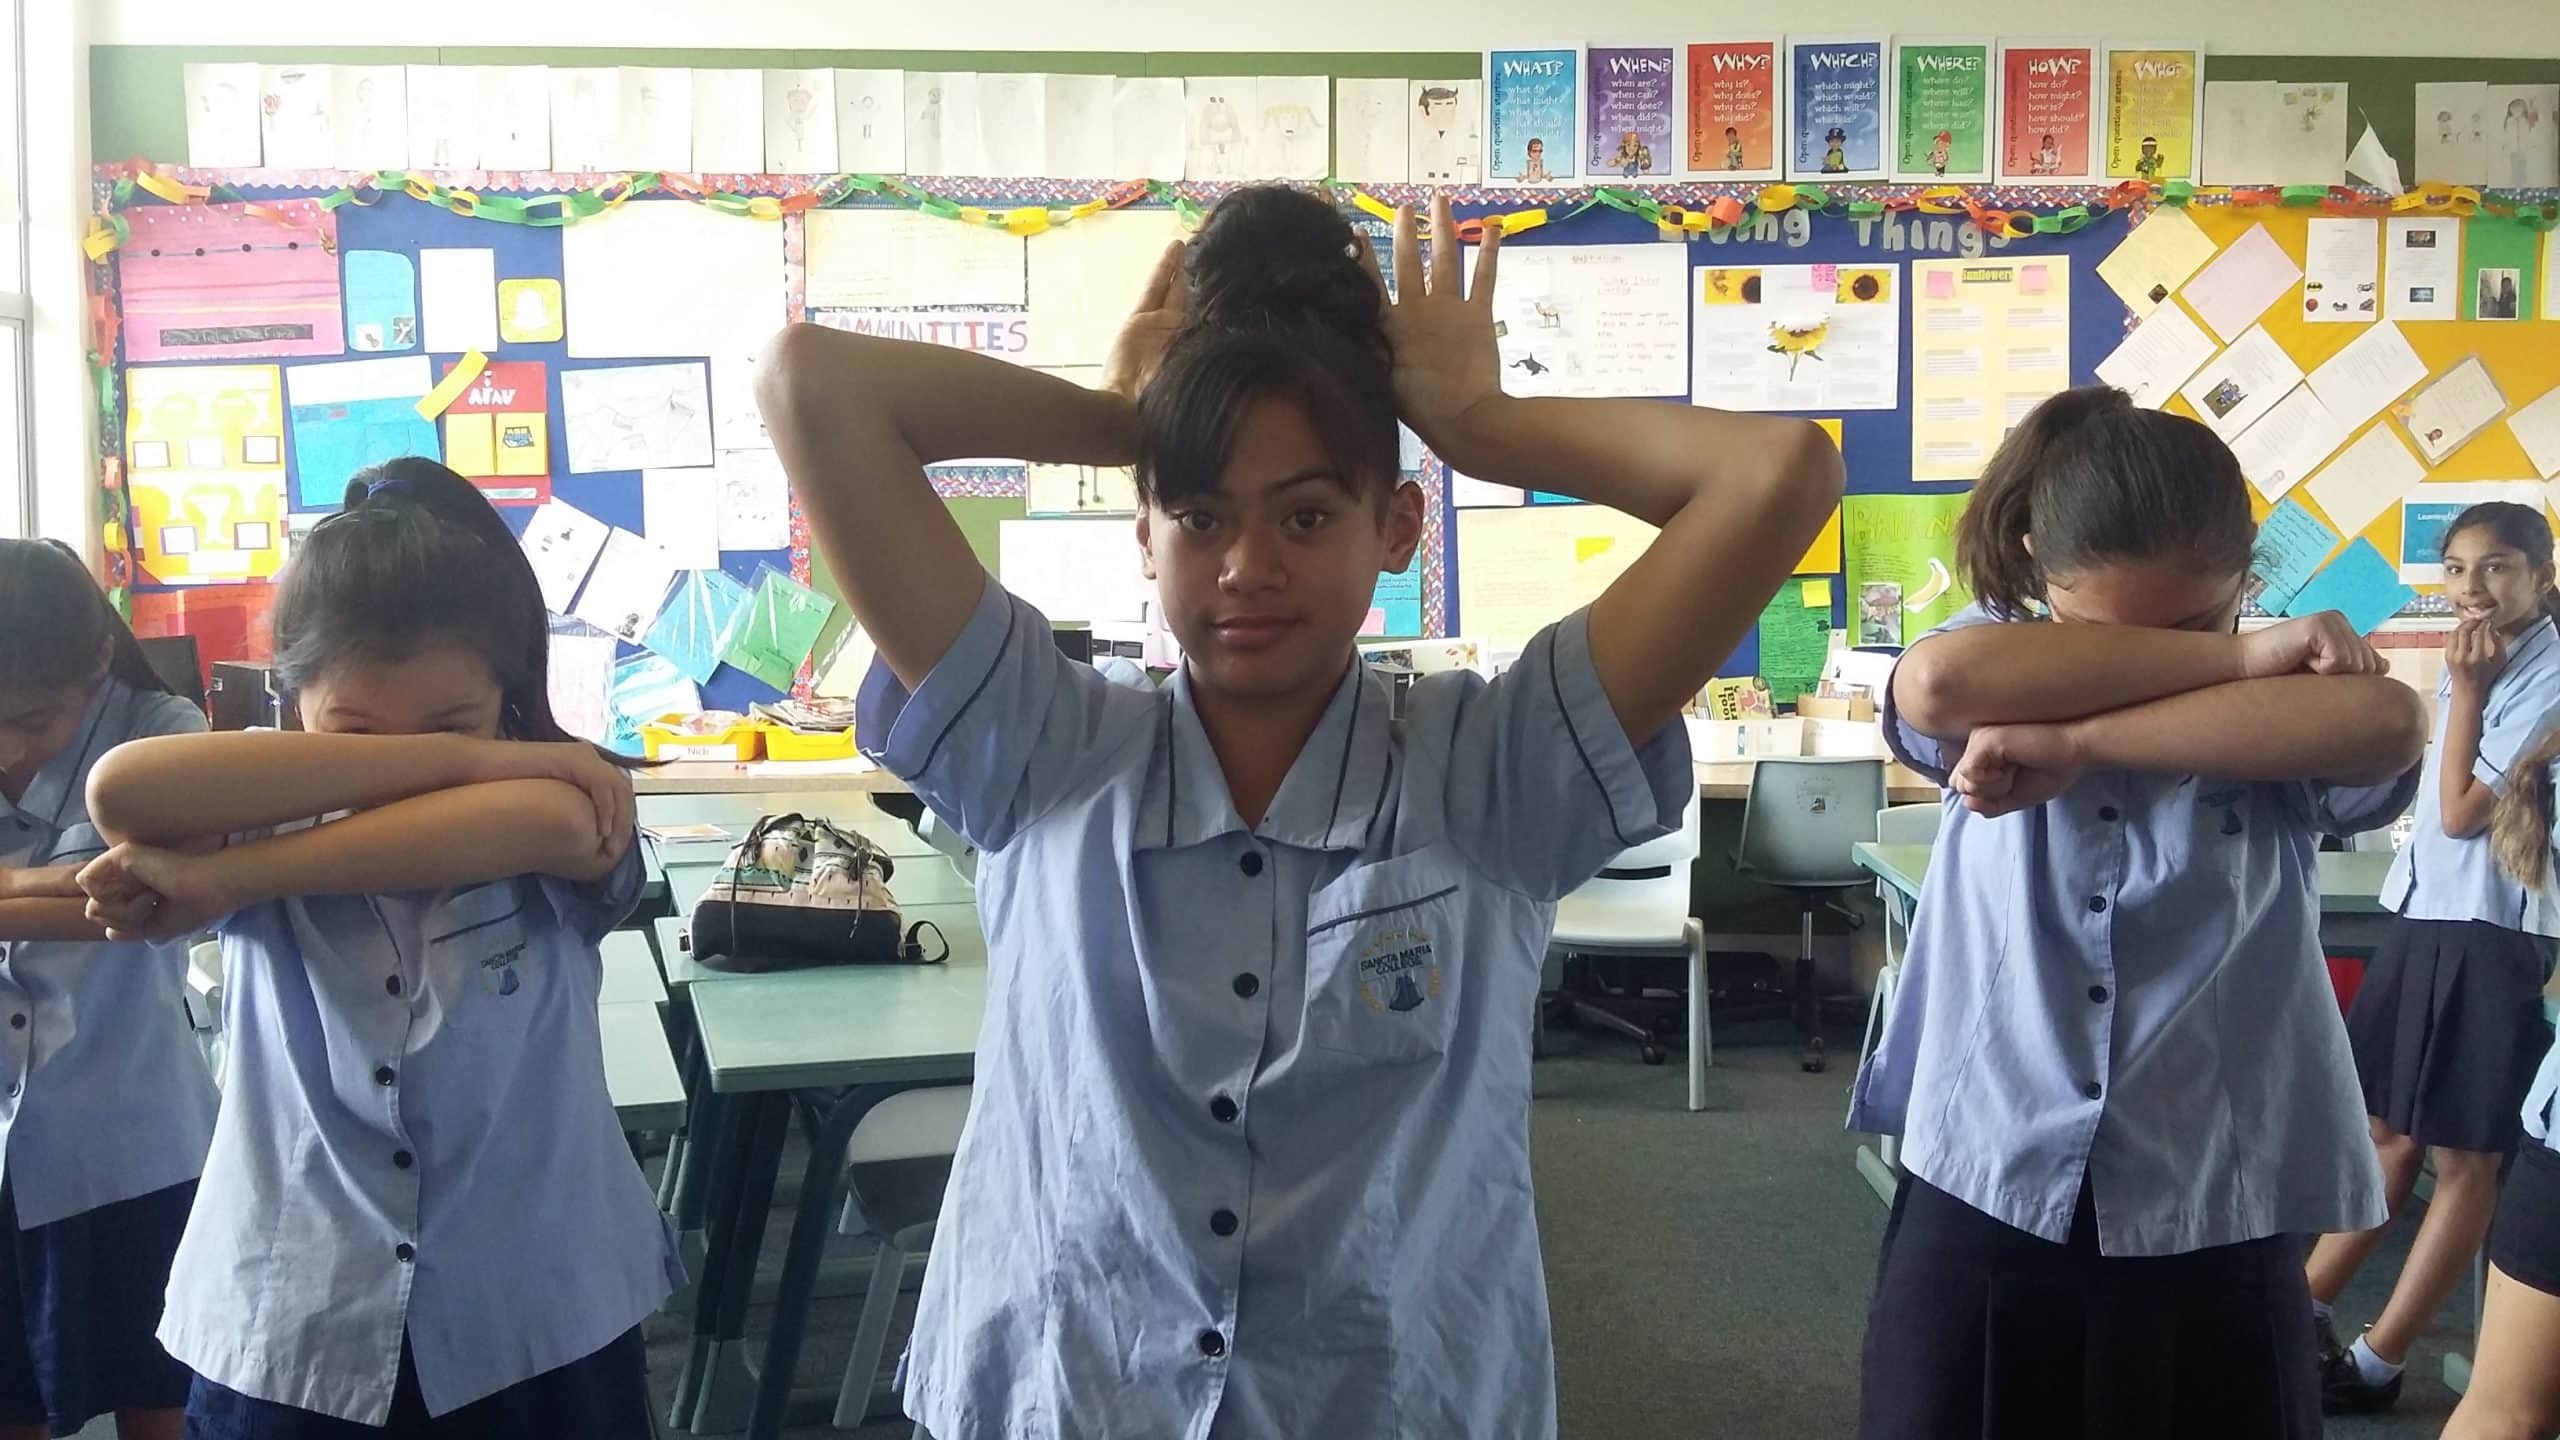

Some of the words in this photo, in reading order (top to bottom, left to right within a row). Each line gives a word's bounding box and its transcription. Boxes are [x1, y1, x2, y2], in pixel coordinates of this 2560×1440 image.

[1609, 56, 1671, 76] WHEN?
[1712, 51, 1771, 74] WHY?
[1916, 54, 1983, 72] WHERE?
[1503, 59, 1564, 78] WHAT?
[1611, 78, 1635, 88] when
[1637, 78, 1657, 88] are?
[1713, 79, 1733, 89] why
[1815, 80, 1841, 90] which
[2028, 79, 2049, 89] how
[2050, 79, 2068, 89] do?
[1612, 89, 1635, 99] when
[1713, 90, 1733, 101] why
[2028, 91, 2049, 101] how
[1611, 101, 1635, 111] when
[1713, 102, 1733, 112] why
[1815, 103, 1841, 113] which
[2028, 103, 2049, 112] how
[1611, 112, 1635, 122] when
[1636, 112, 1657, 122] did?
[1361, 953, 1398, 972] SANCTA
[1400, 944, 1432, 959] MARIA
